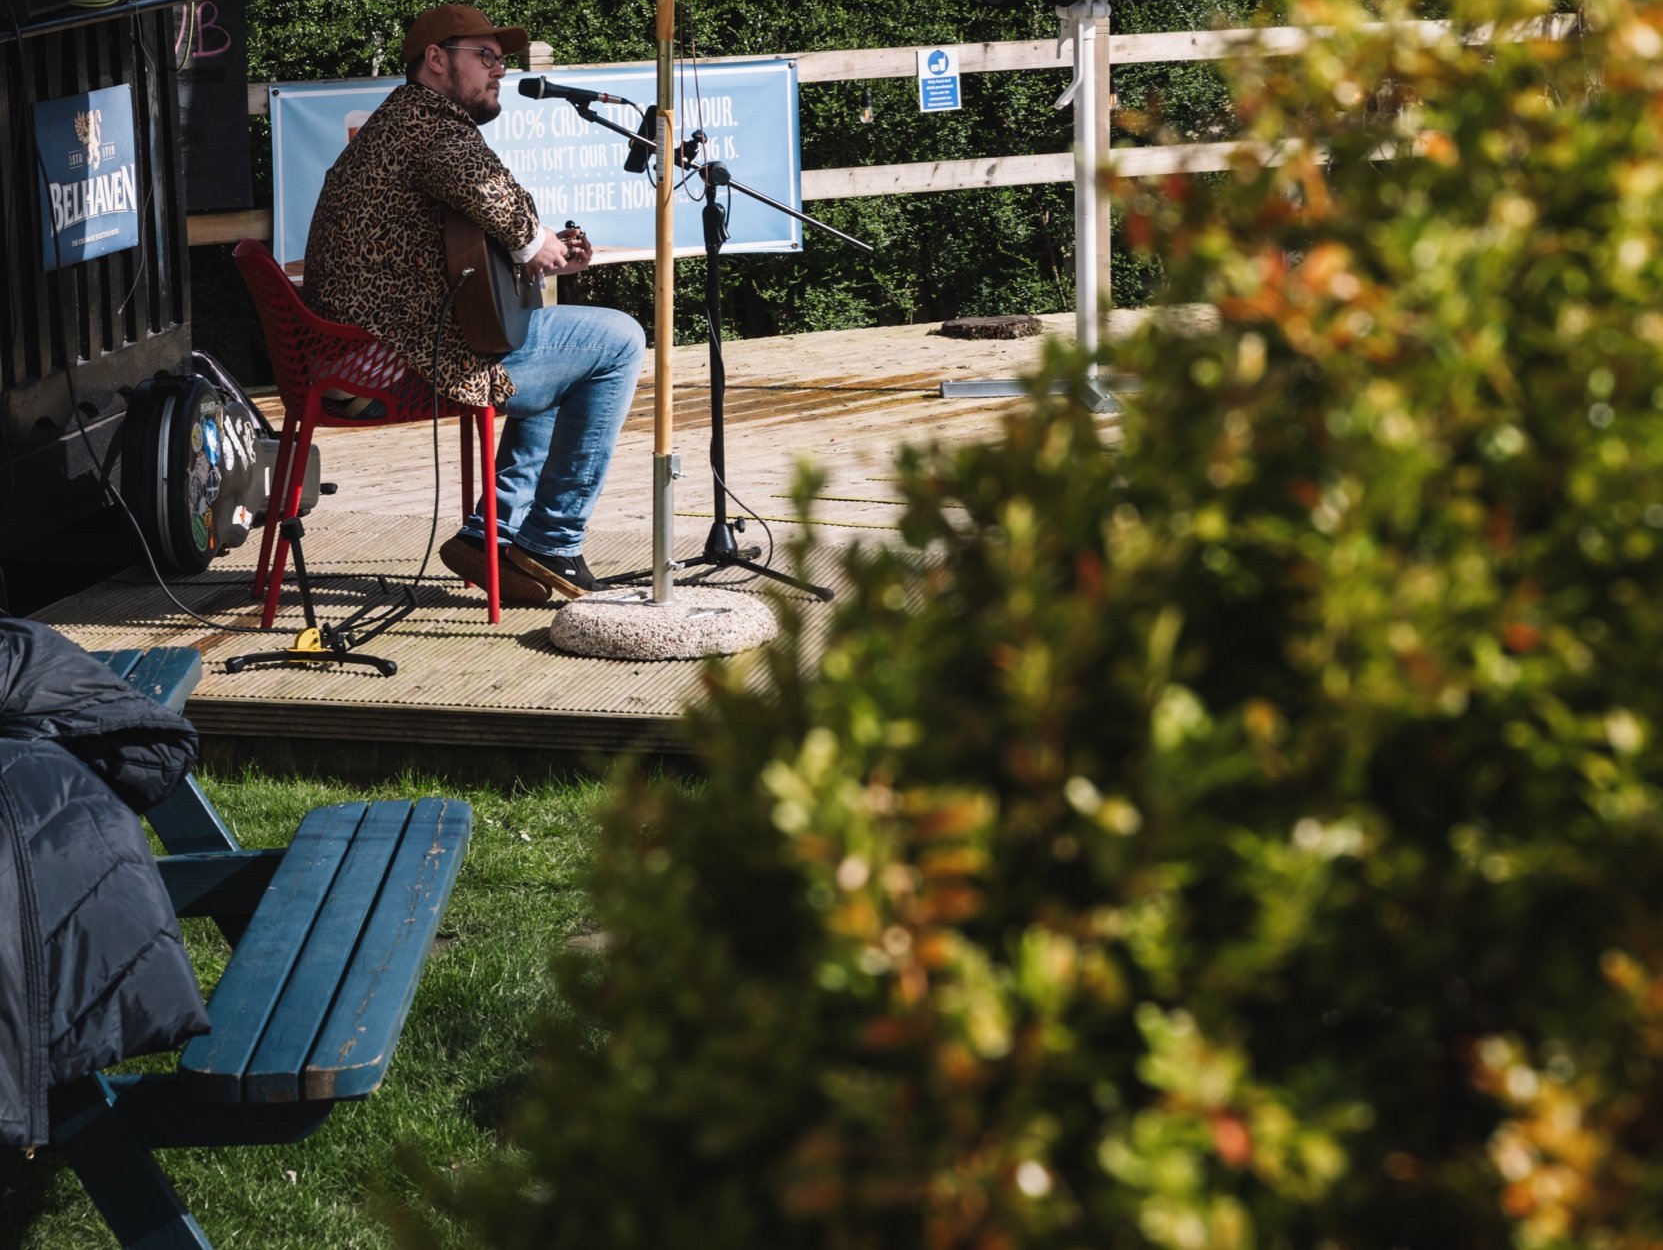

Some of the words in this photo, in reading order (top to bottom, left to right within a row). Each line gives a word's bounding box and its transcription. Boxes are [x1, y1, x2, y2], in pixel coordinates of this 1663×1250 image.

[673, 95, 739, 130] LAVOUR.
[542, 145, 576, 171] ISN'T
[579, 142, 608, 169] OUR
[49, 163, 138, 238] BELHAVEN
[574, 180, 617, 213] HERE
